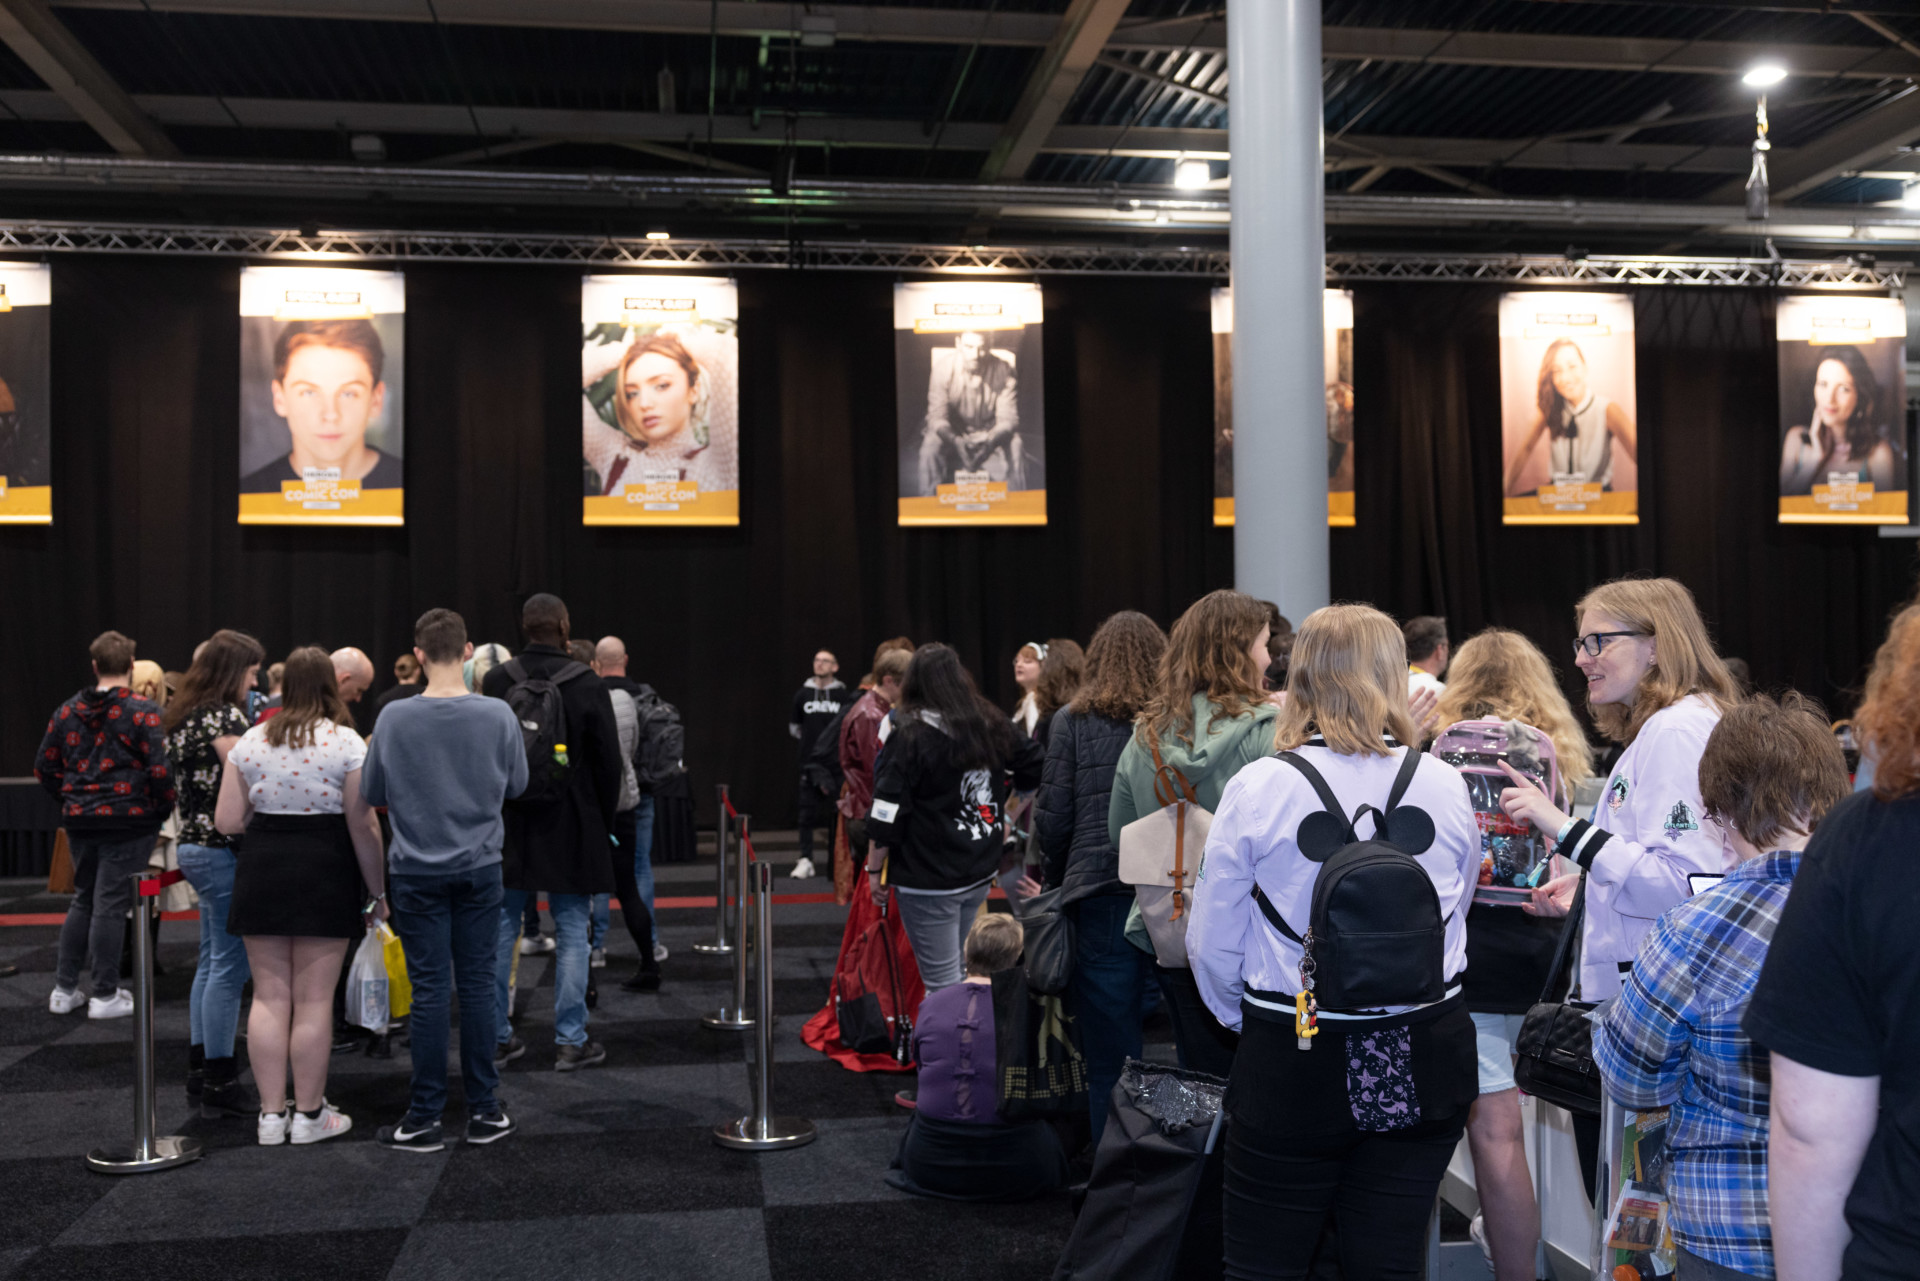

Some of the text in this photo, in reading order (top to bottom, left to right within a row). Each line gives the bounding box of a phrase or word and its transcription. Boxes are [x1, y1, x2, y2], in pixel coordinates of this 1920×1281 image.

[285, 487, 359, 501] COMIC CON
[627, 488, 696, 503] COMIC CON
[939, 489, 1006, 504] COMIC CON
[803, 700, 841, 714] CREW
